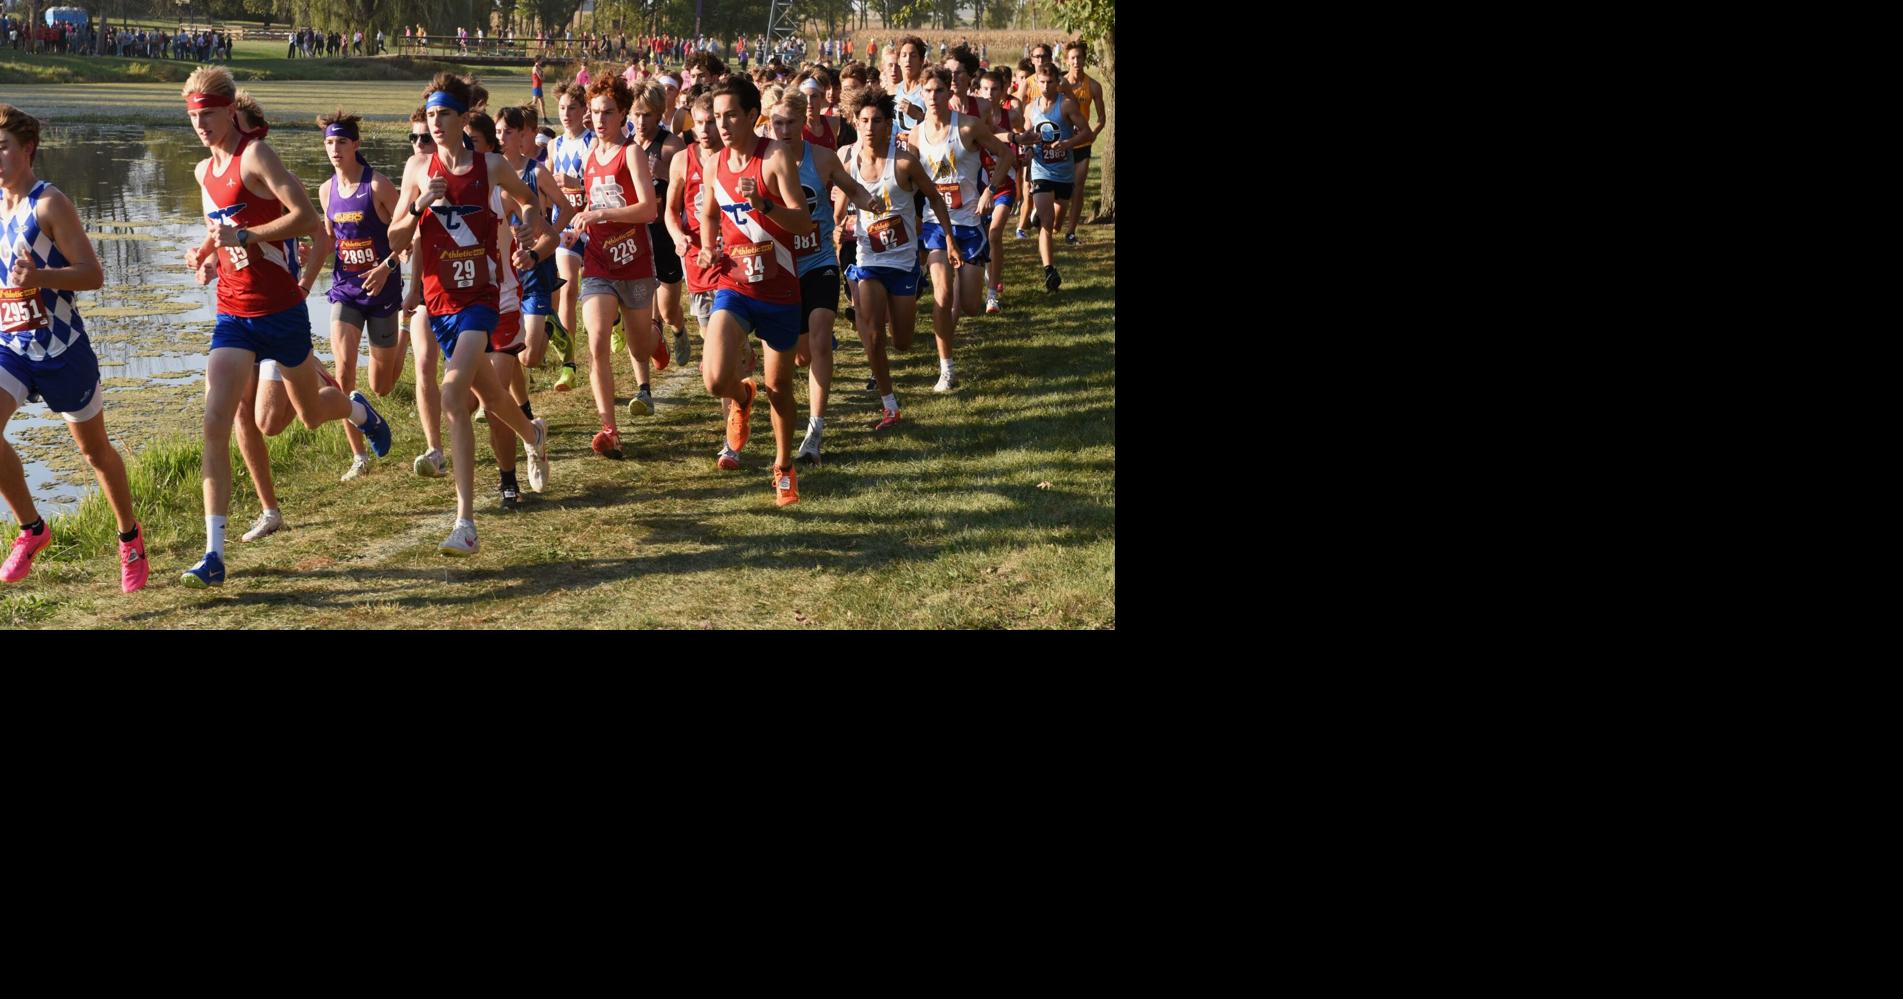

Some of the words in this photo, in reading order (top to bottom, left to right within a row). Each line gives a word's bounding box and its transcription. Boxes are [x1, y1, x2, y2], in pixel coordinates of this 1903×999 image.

[880, 229, 897, 245] 62
[343, 249, 374, 264] 2899
[610, 239, 637, 262] 228
[453, 260, 475, 280] 29
[743, 255, 764, 276] 34
[2, 299, 42, 322] 2951
